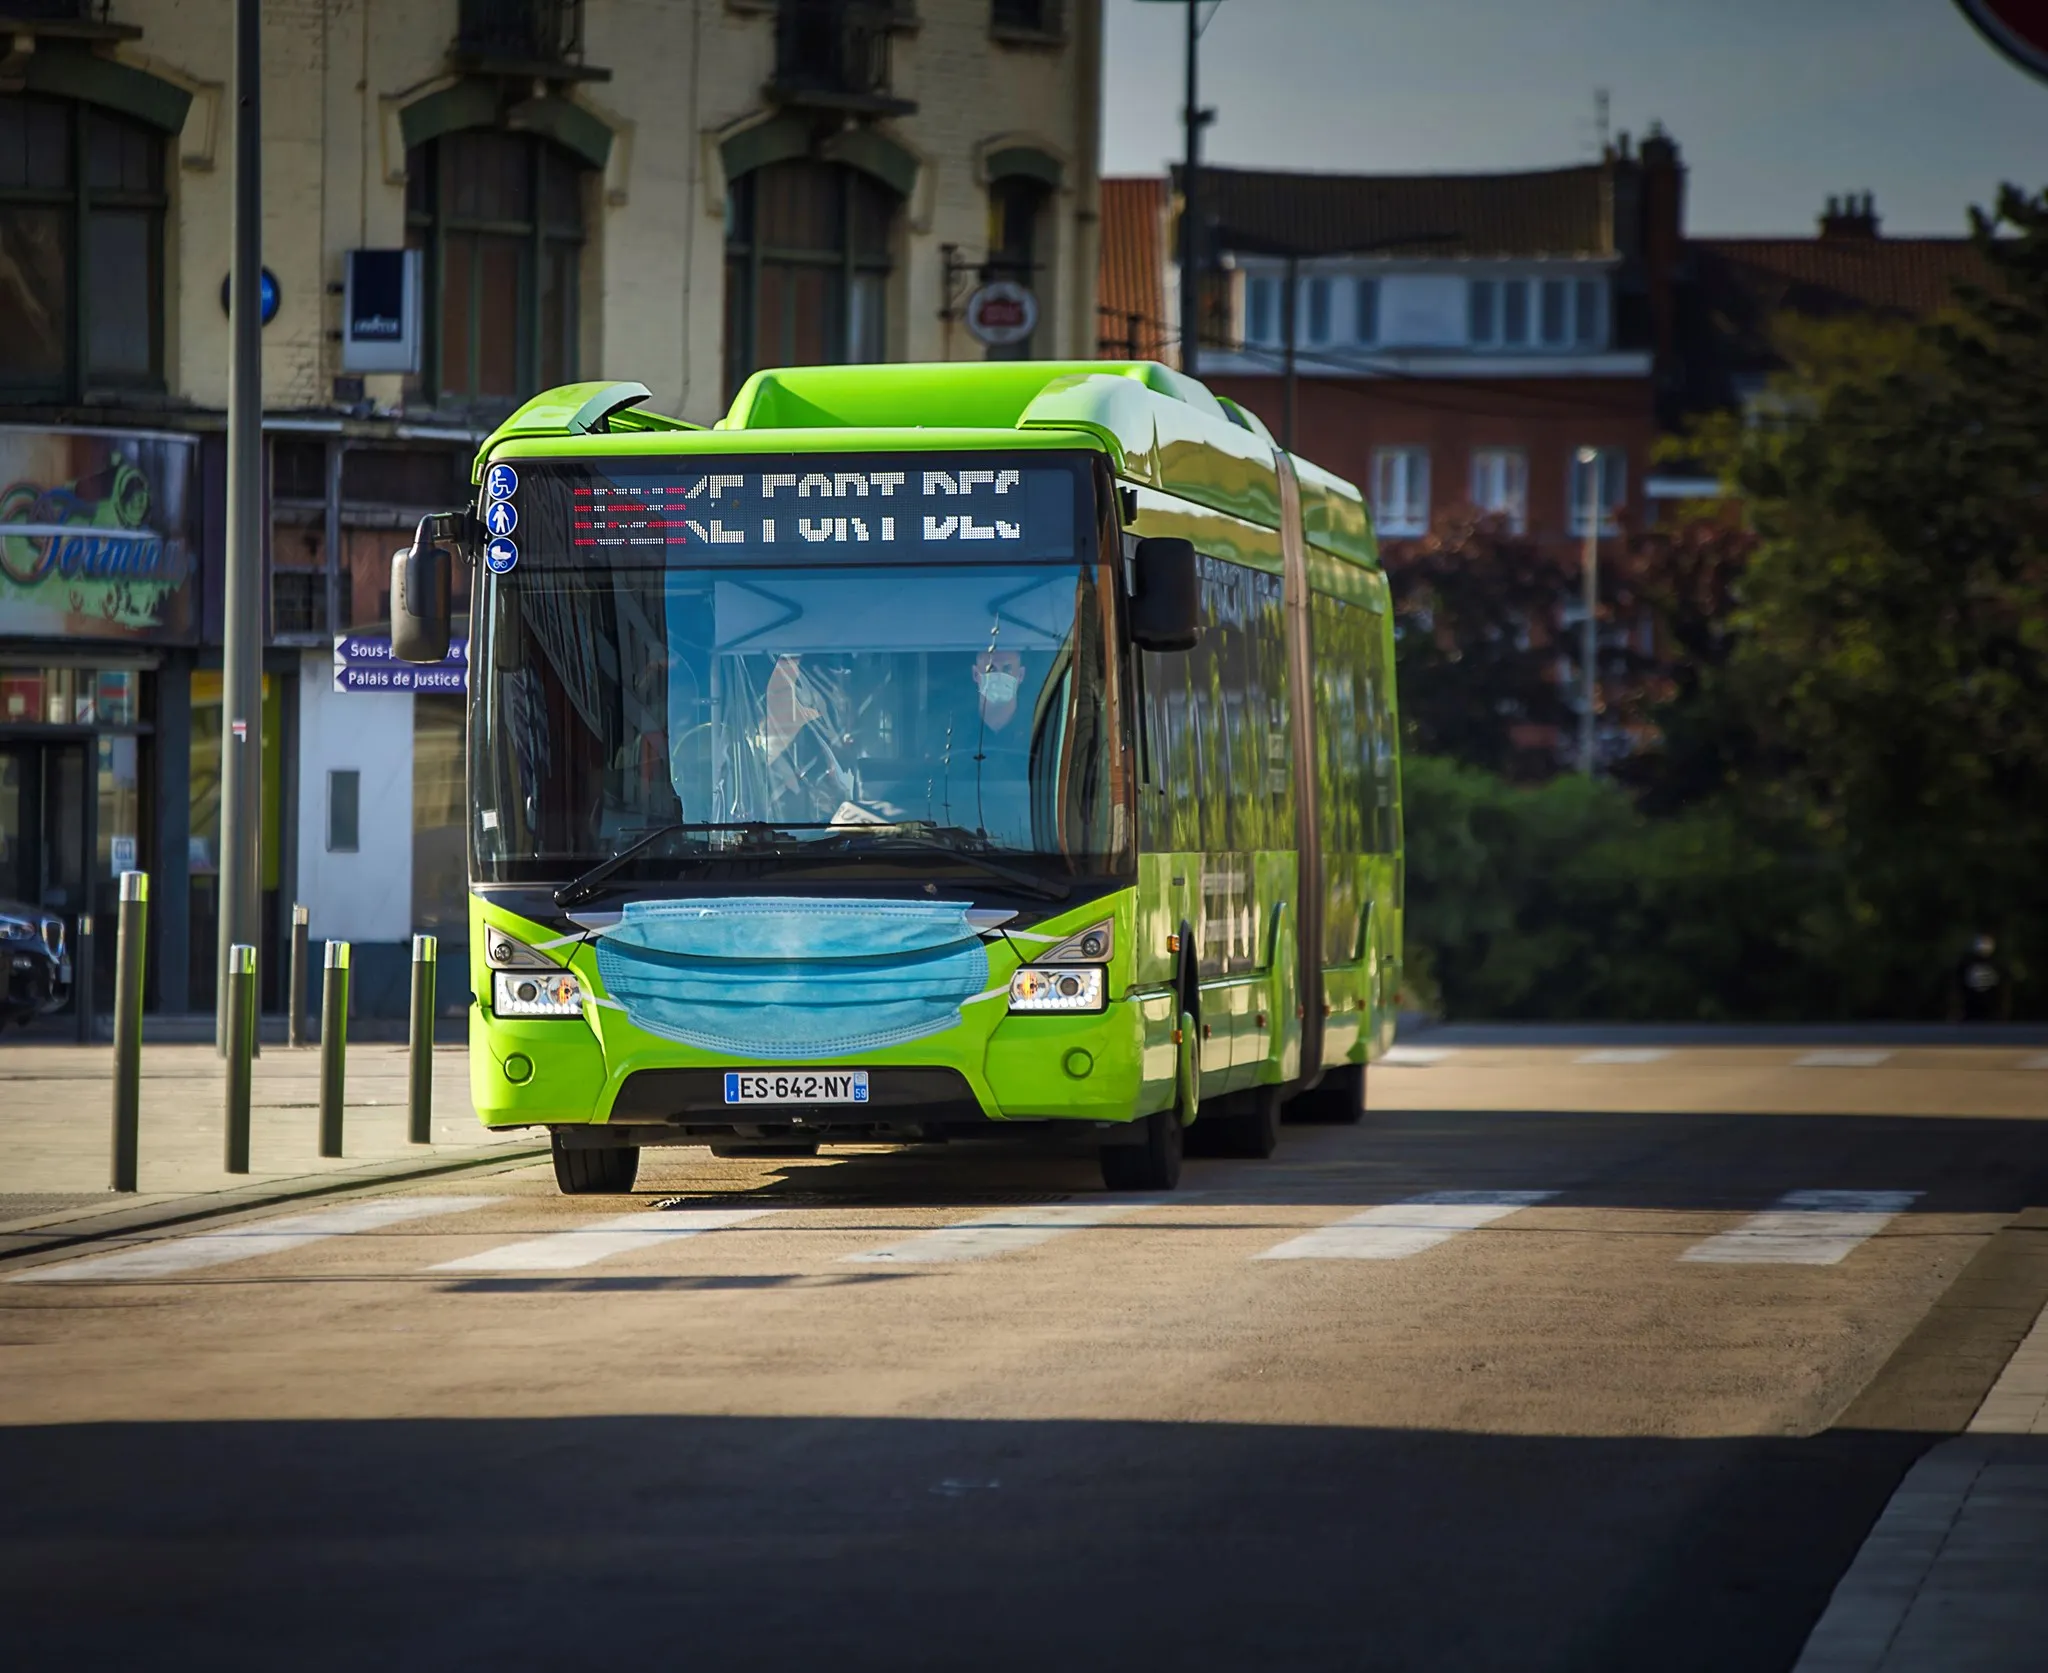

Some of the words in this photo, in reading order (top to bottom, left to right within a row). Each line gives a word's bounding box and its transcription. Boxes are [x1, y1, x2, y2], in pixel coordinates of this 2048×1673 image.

[762, 473, 906, 542] FORT
[348, 672, 389, 687] Palais
[392, 672, 412, 687] de
[413, 672, 461, 689] Justice
[741, 1077, 852, 1099] ES-642-NY
[855, 1088, 867, 1099] 59
